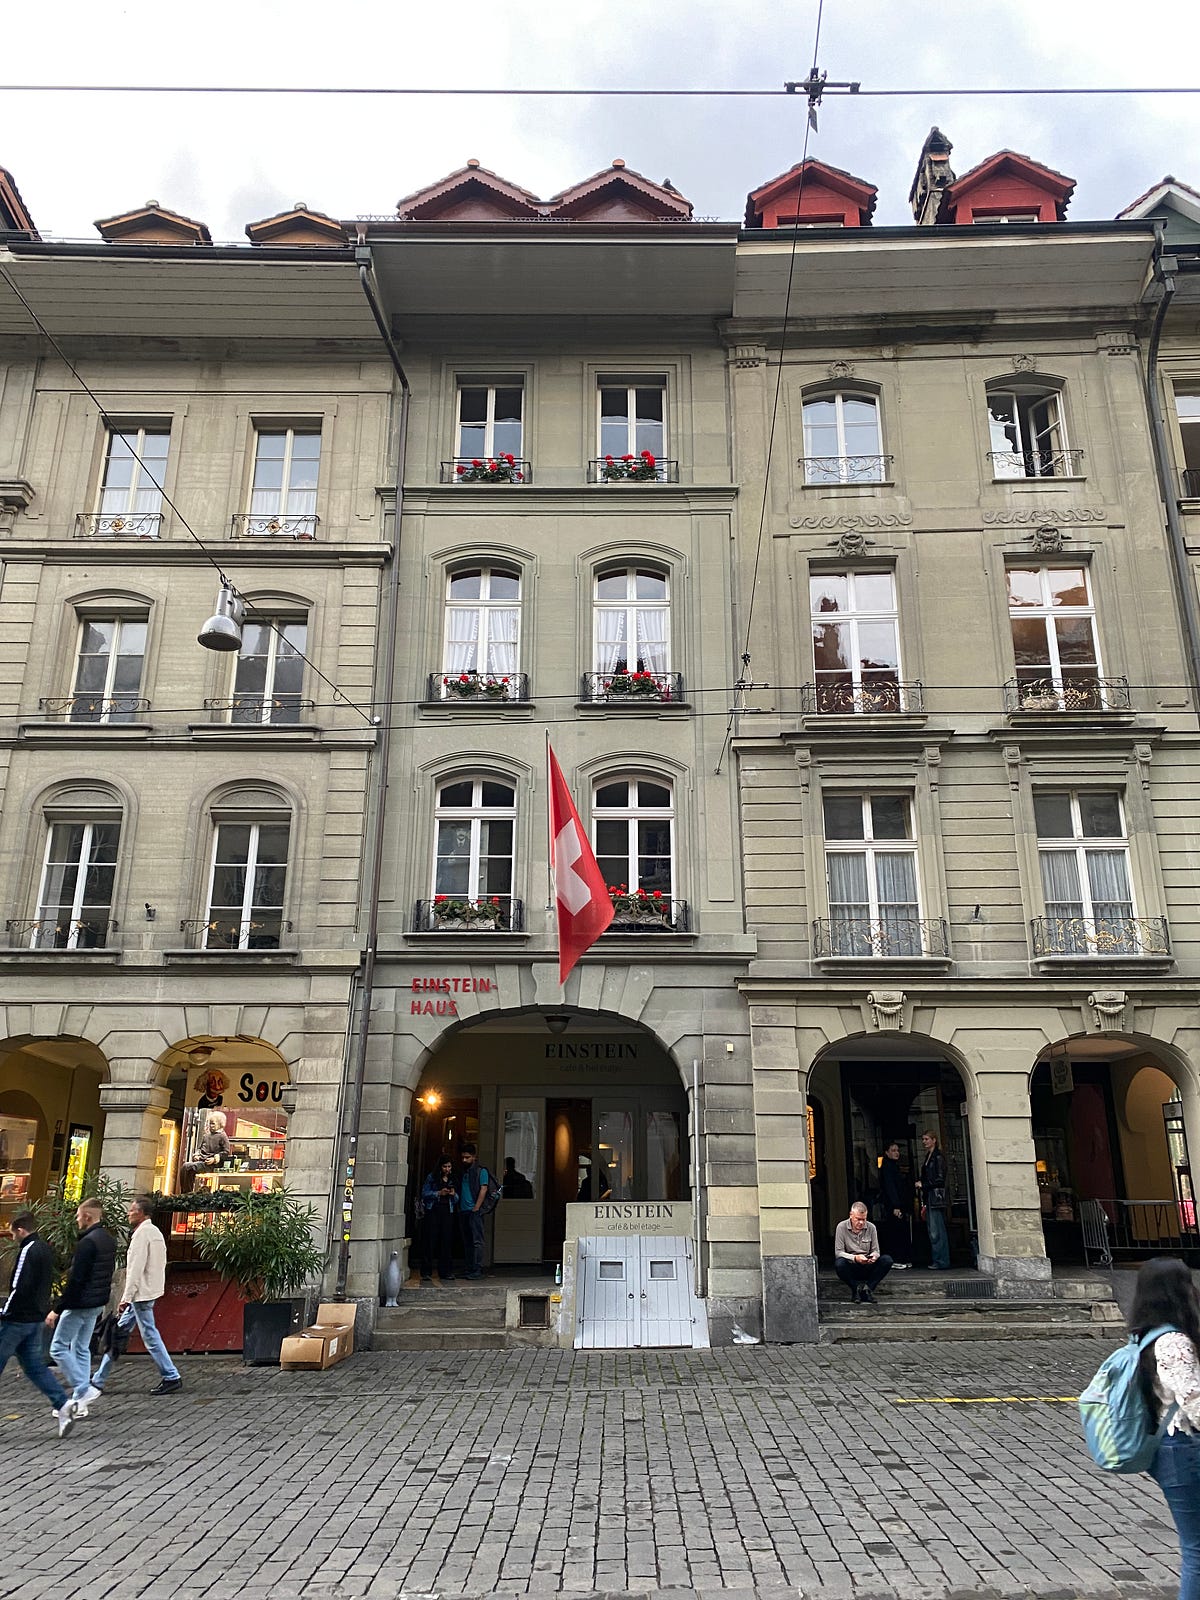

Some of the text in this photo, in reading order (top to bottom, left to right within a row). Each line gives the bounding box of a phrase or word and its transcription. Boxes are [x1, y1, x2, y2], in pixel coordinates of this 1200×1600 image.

[411, 977, 498, 993] EINSTEIN-
[410, 1000, 457, 1015] HAUS
[545, 1043, 639, 1058] EINSTEIN
[594, 1204, 673, 1219] EINSTEIN
